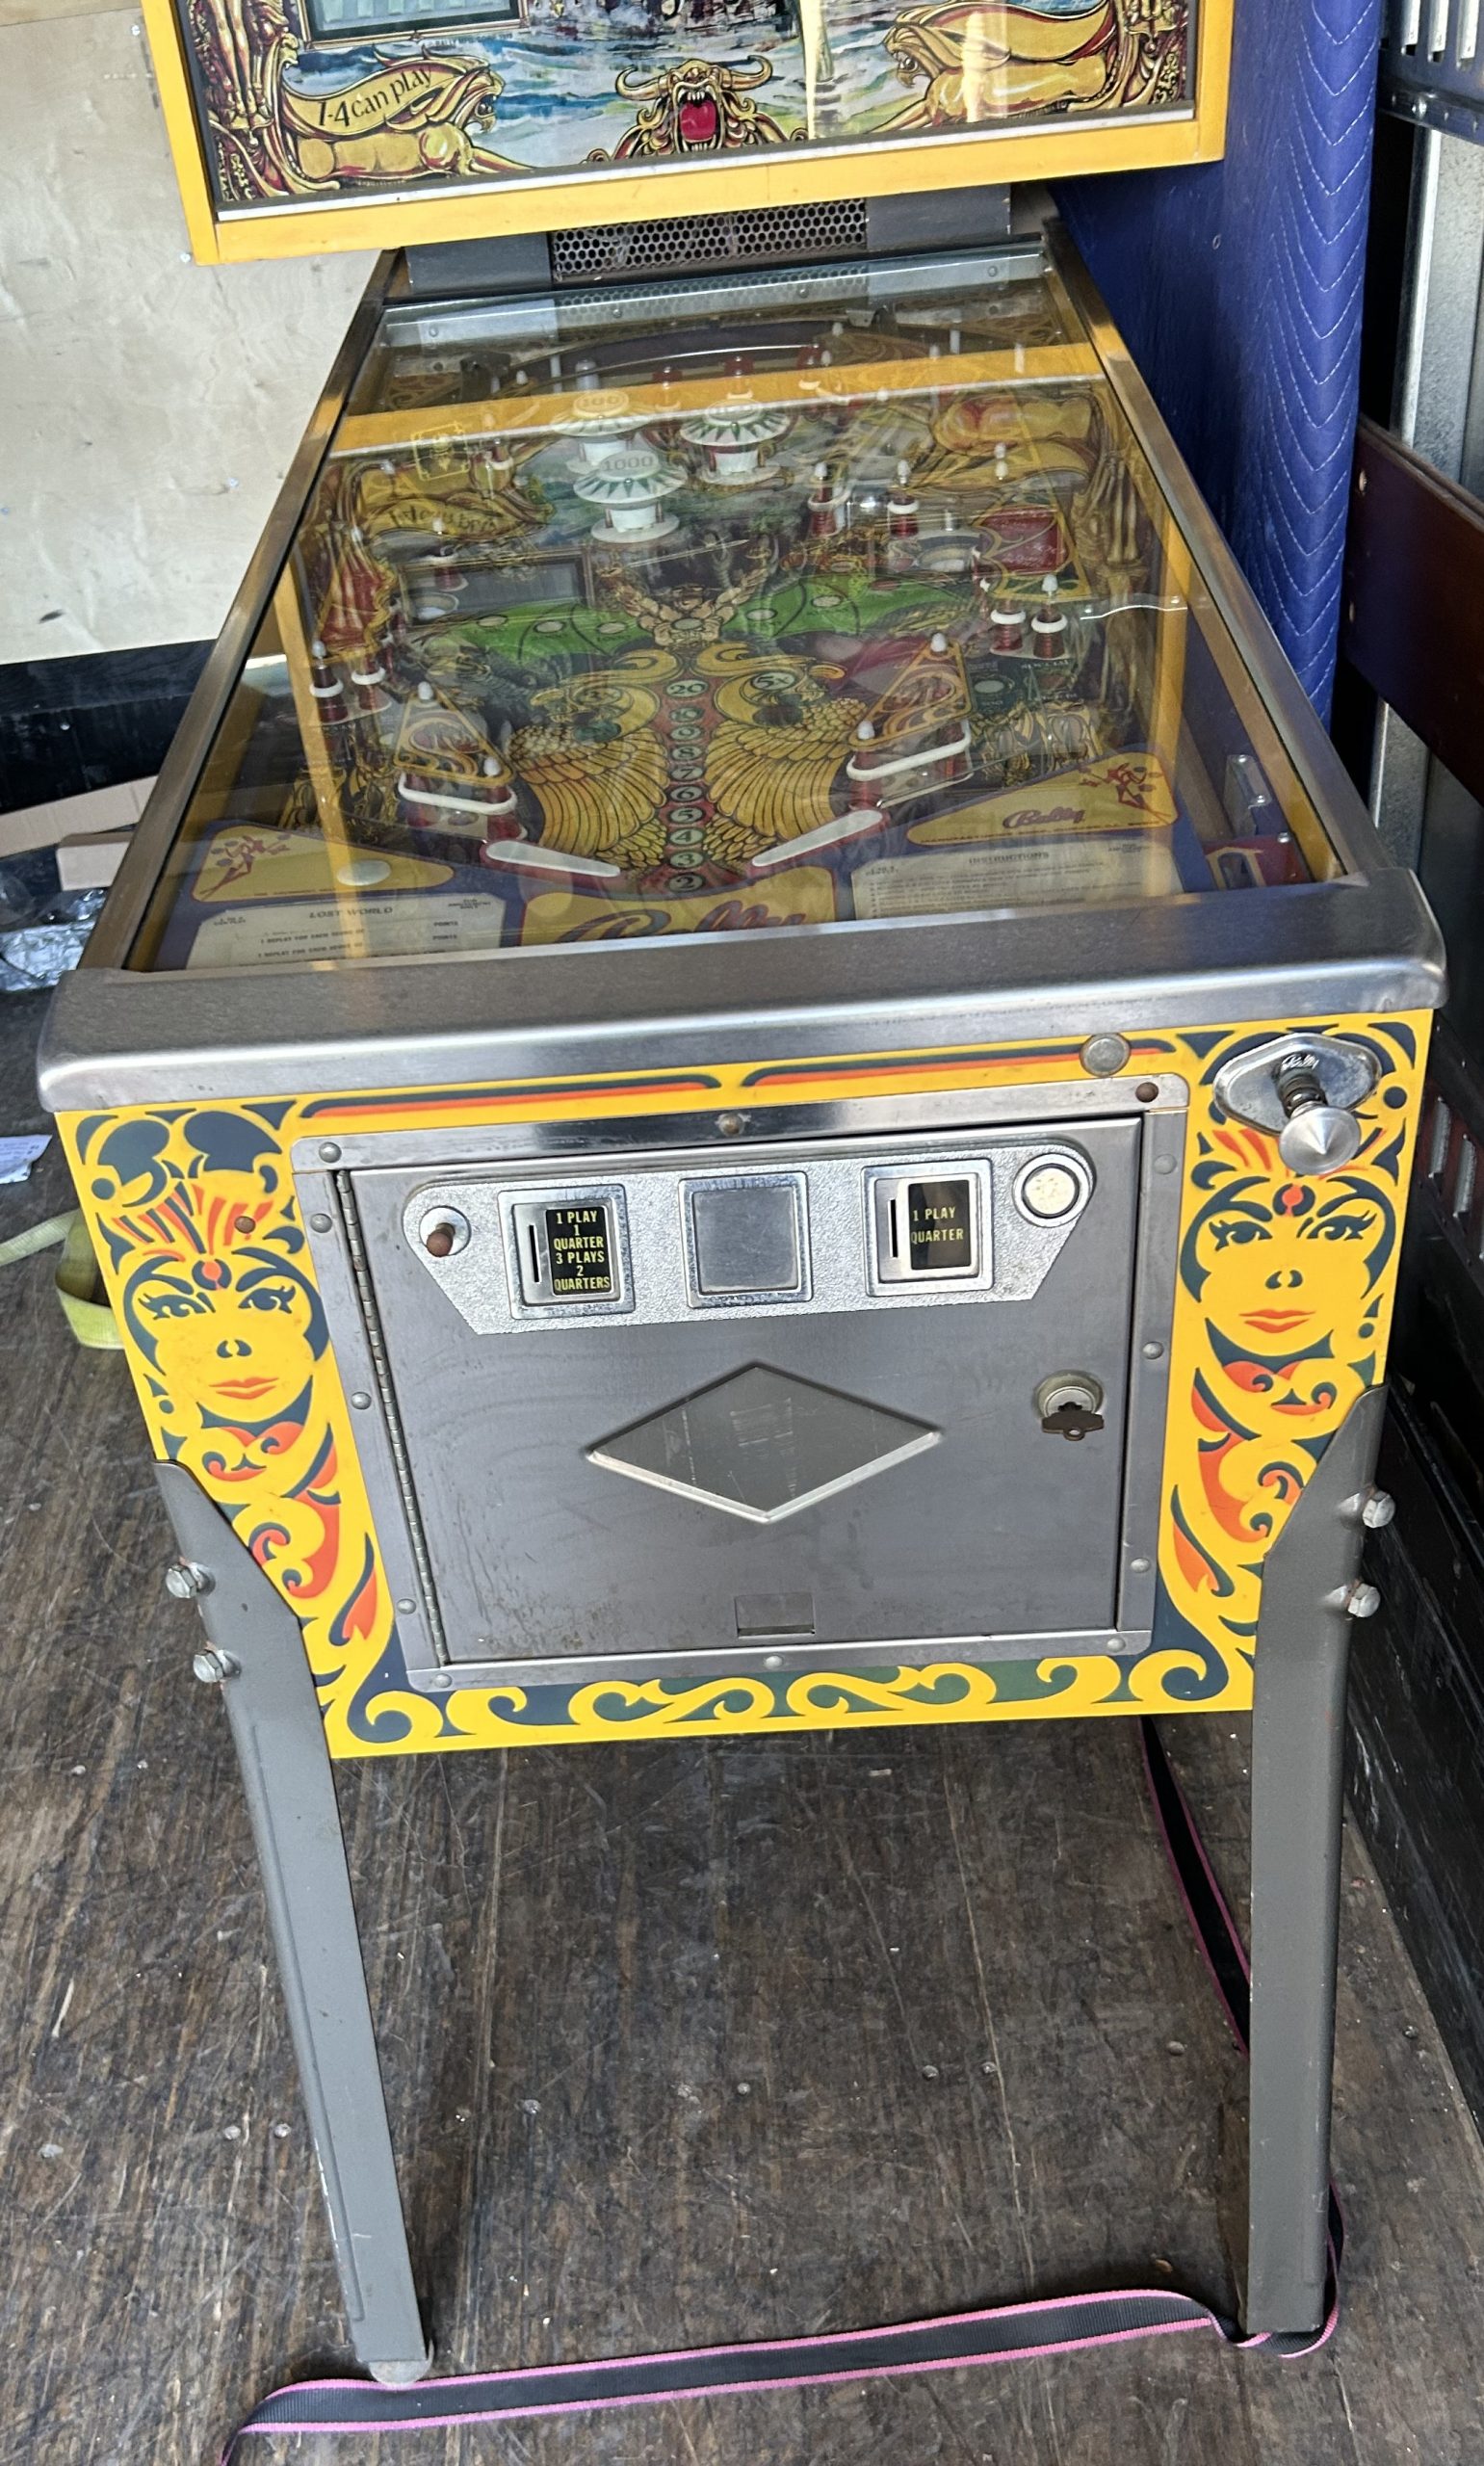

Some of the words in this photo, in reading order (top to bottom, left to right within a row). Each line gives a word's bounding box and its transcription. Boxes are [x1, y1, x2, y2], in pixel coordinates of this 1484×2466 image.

[318, 99, 351, 127] 1-4
[351, 91, 389, 118] can
[389, 66, 432, 104] play
[603, 456, 654, 472] 1000
[669, 683, 707, 695] 20
[677, 768, 694, 779] 7
[677, 786, 695, 800] 6
[677, 809, 694, 821] 5
[1002, 806, 1085, 829] Bally
[675, 830, 692, 843] 4
[677, 853, 695, 868] 3
[676, 876, 694, 889] 2
[556, 1212, 562, 1224] 1
[567, 1210, 597, 1224] PLAY
[913, 1209, 919, 1221] 1
[924, 1206, 956, 1220] PLAY
[573, 1223, 580, 1236] 1
[910, 1227, 964, 1245] QUARTER
[553, 1236, 604, 1251] QUARTER
[556, 1252, 563, 1265] 3
[567, 1250, 605, 1264] PLAYS
[576, 1265, 584, 1277] 2
[554, 1276, 611, 1292] QUARTERS
